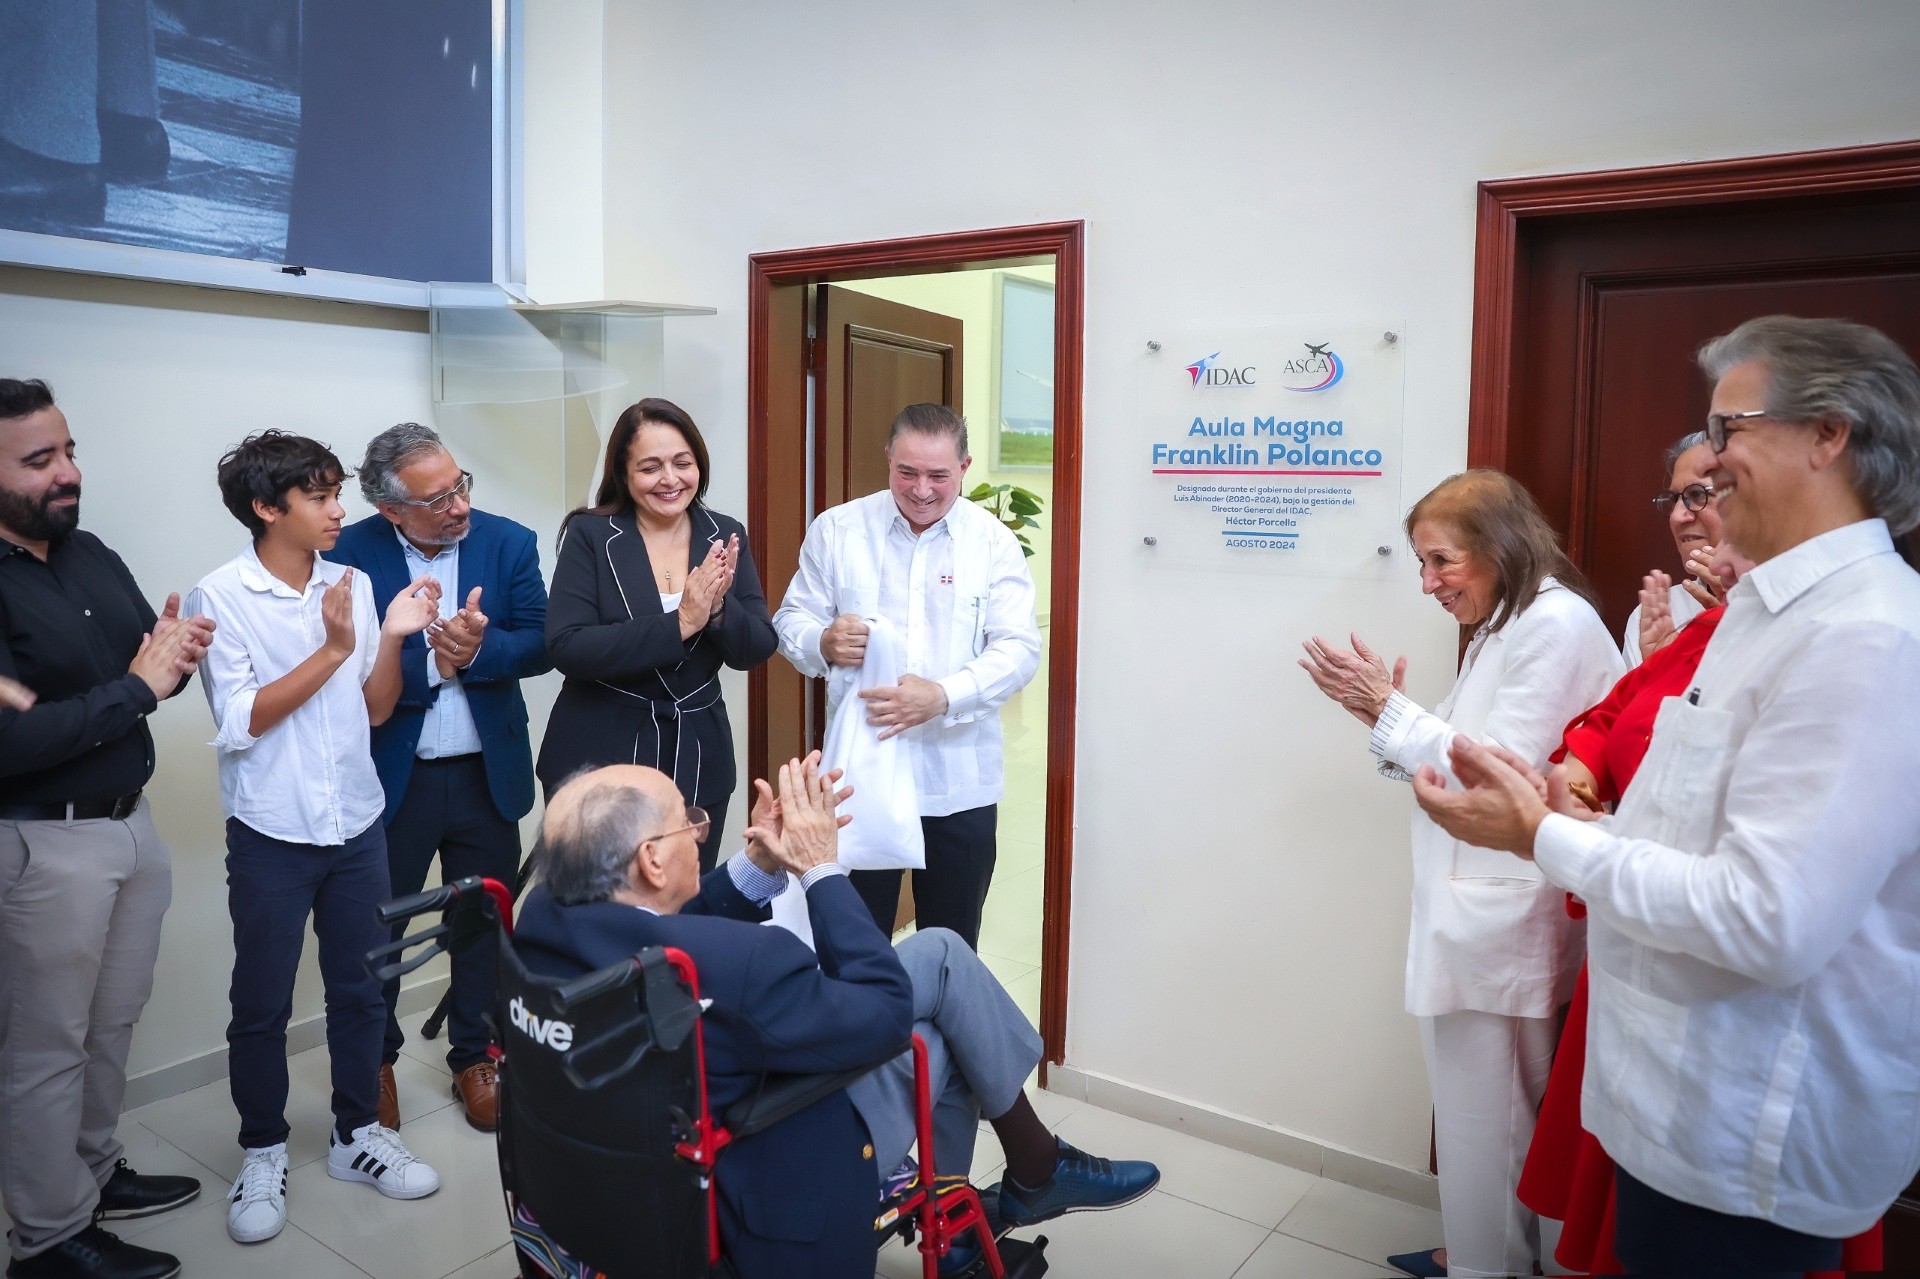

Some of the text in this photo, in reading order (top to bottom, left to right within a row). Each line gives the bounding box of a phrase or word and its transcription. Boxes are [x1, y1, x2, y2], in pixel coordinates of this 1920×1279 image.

[1283, 358, 1329, 374] ASCA
[1206, 367, 1256, 385] IDAC
[1188, 416, 1343, 444] Aula Magna
[1152, 443, 1383, 466] Franklin Polanco
[1177, 484, 1217, 494] Designado
[1217, 485, 1248, 493] durante
[1257, 486, 1293, 495] gobierno
[1307, 487, 1352, 495] presidente
[1173, 494, 1189, 502] Luis
[1189, 494, 1225, 502] Abinader
[1282, 497, 1300, 506] bajo
[1310, 497, 1341, 507] gestión
[1211, 505, 1312, 516] Director General del IDAC,
[1225, 516, 1297, 527] Héctor Porcella
[1225, 539, 1296, 550] AGOSTO 2024
[509, 995, 573, 1052] drive
